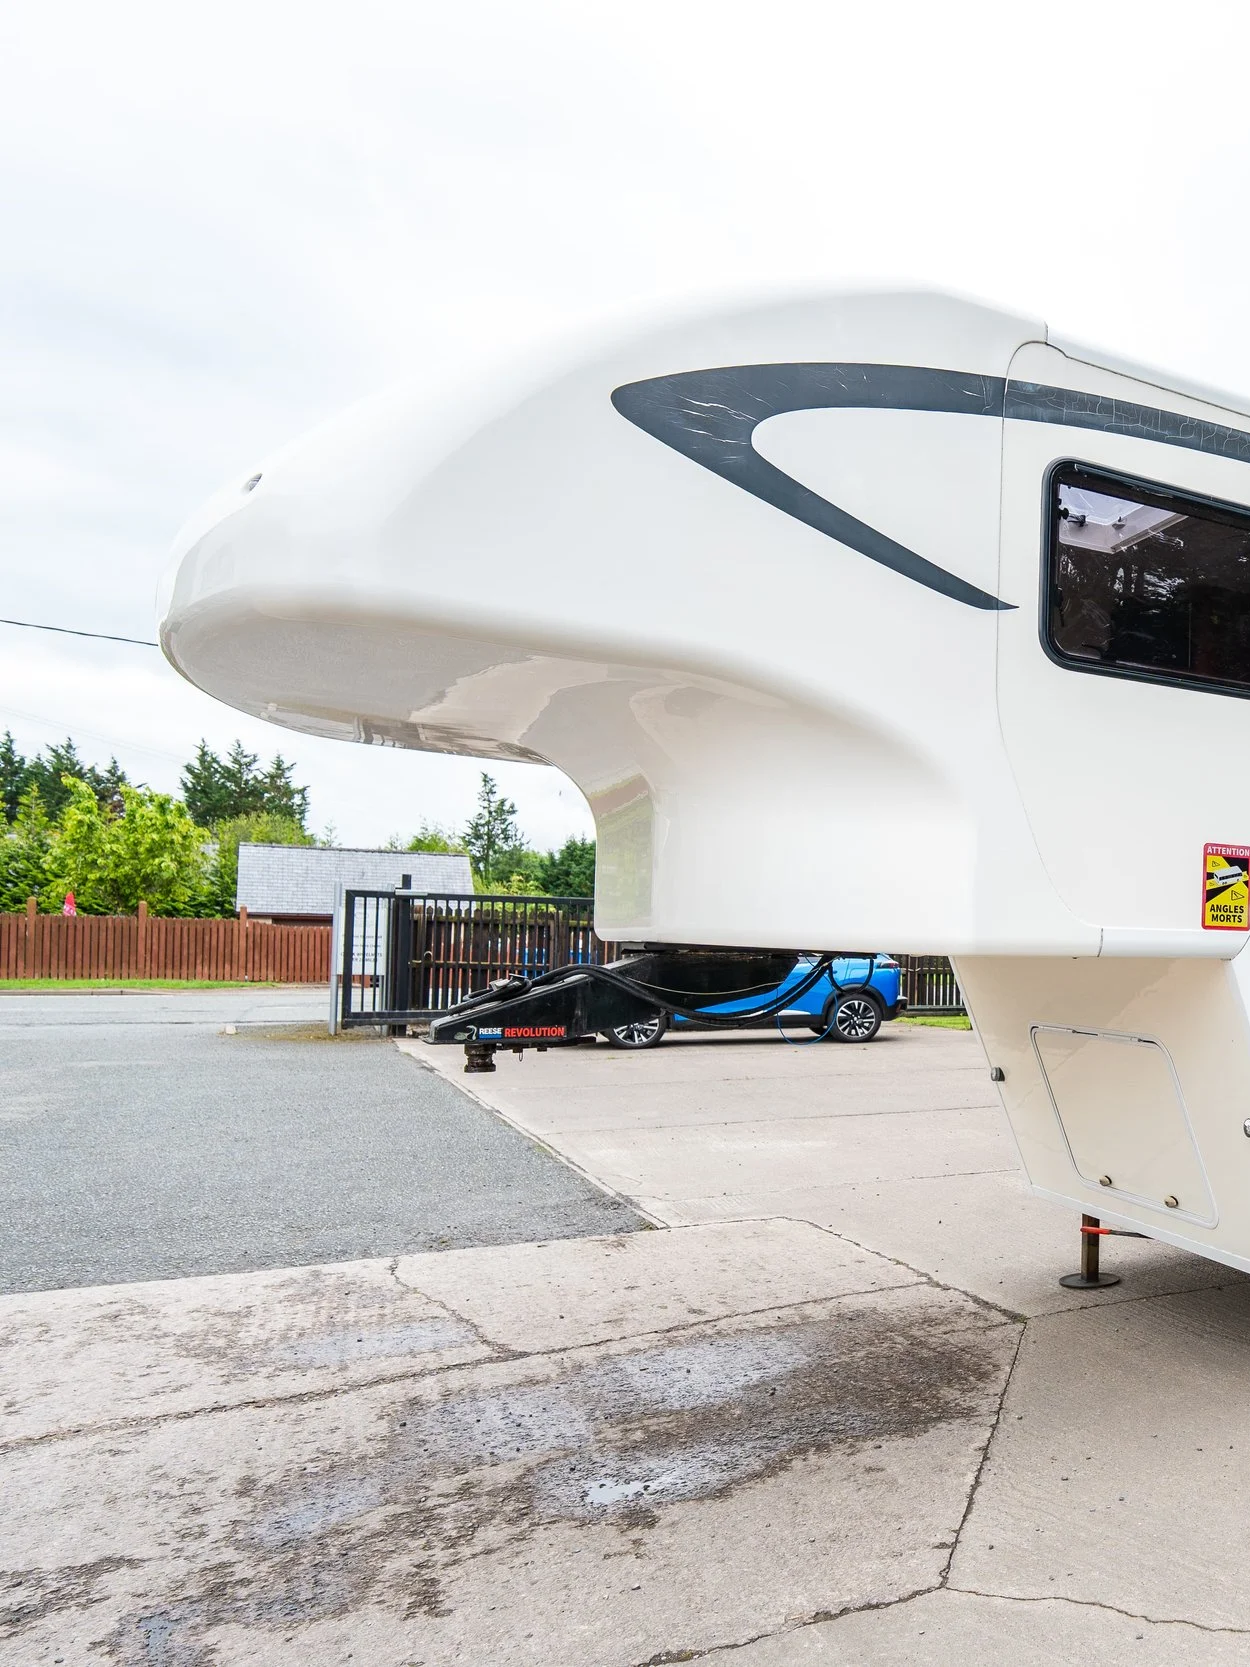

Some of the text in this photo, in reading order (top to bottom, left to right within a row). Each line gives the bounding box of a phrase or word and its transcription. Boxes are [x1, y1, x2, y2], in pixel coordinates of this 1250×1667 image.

[1207, 846, 1250, 856] ATTENTION
[1210, 904, 1244, 913] ANGLES
[1212, 914, 1242, 923] MORTS
[479, 1027, 565, 1037] REESE REVOLUTION
